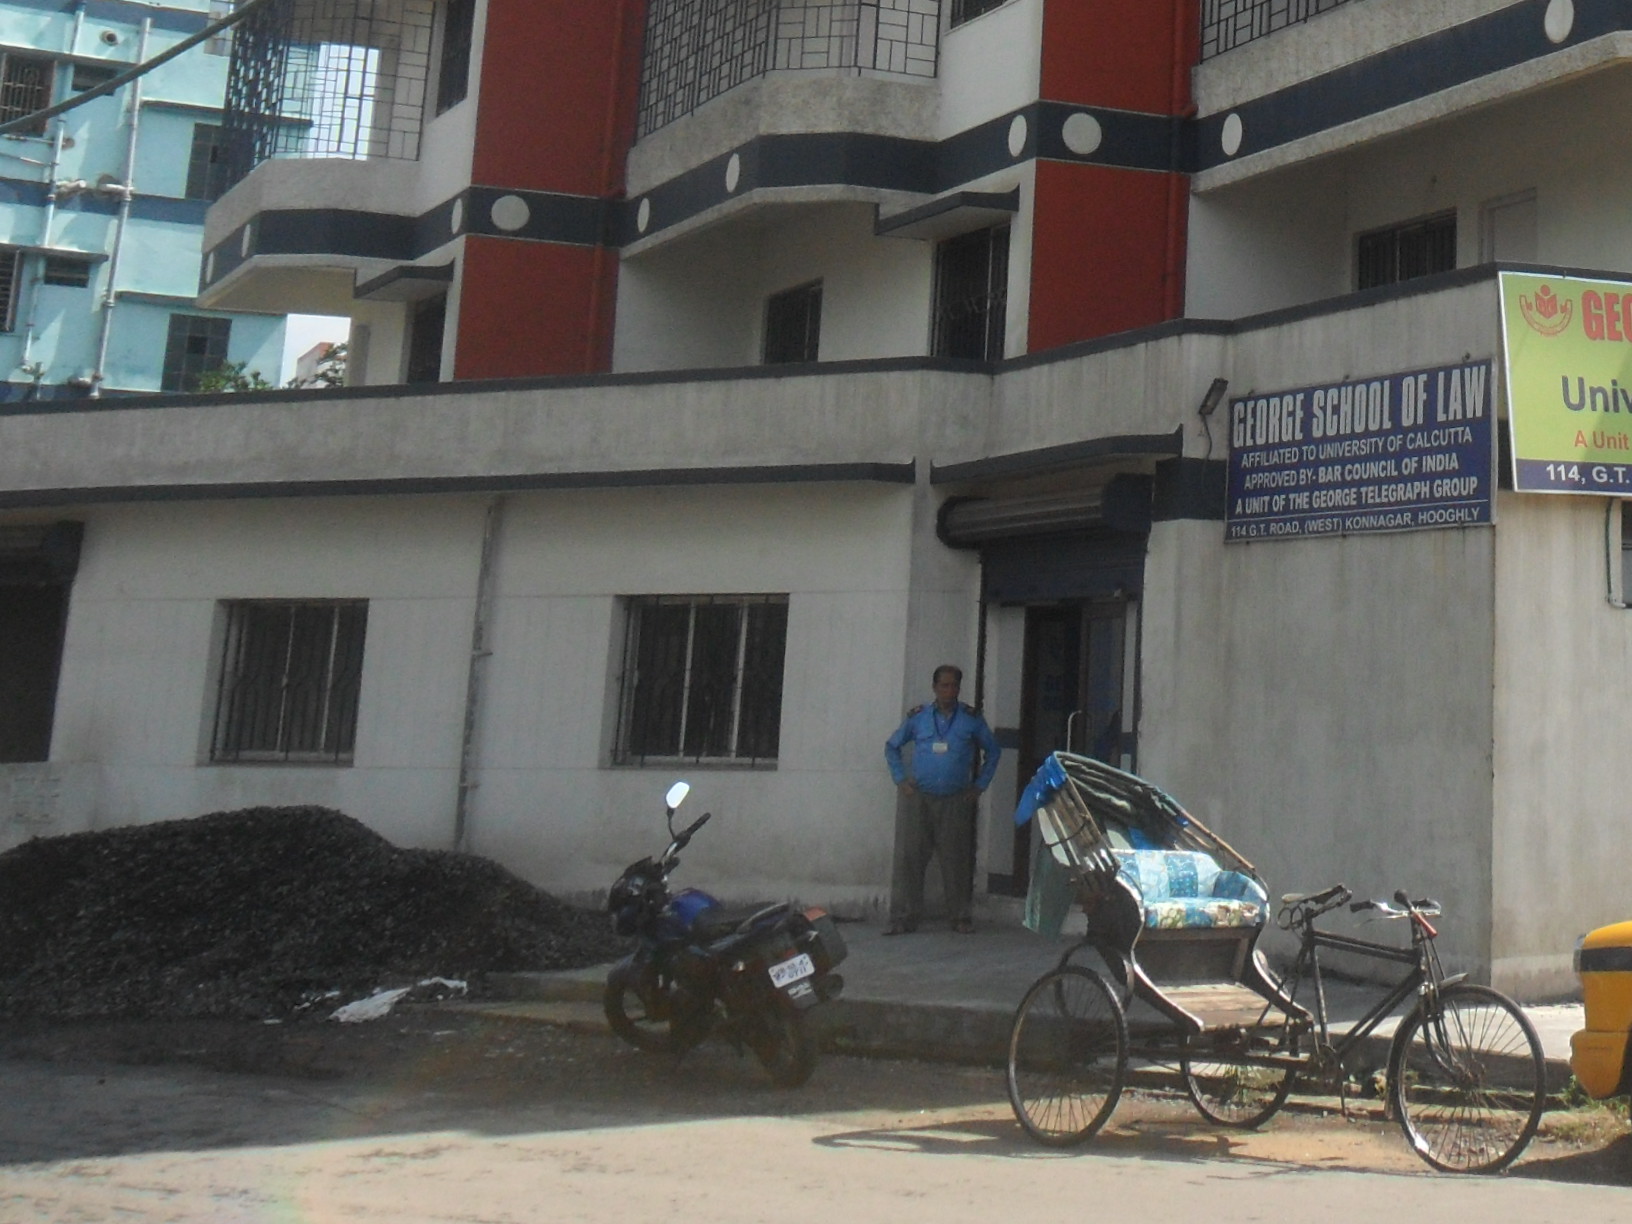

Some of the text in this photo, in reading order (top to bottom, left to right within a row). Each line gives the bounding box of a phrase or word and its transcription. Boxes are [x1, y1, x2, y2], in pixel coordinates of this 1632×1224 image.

[1233, 365, 1486, 448] GEORGE SCHOOL OF LAW
[1241, 426, 1473, 468] AFFILIATED TO UNIVERSITY OF CALCUTTA
[1574, 430, 1588, 448] A
[1593, 431, 1629, 450] Unit
[1244, 470, 1297, 490] APPROVED
[1318, 466, 1341, 484] BAR
[1344, 461, 1398, 481] COUNCIL
[1402, 457, 1418, 475] OF
[1422, 453, 1459, 473] INDIA
[1546, 463, 1586, 484] 114,
[1592, 466, 1630, 484] G.T.
[1235, 476, 1478, 516] A UNIT OF THE GEORGE TELEGRAPH GROUP
[1231, 525, 1246, 537] 114
[1304, 518, 1342, 534] (WEST)
[1345, 512, 1414, 530] KONNAGAR,
[1418, 507, 1480, 524] HOOGHLY
